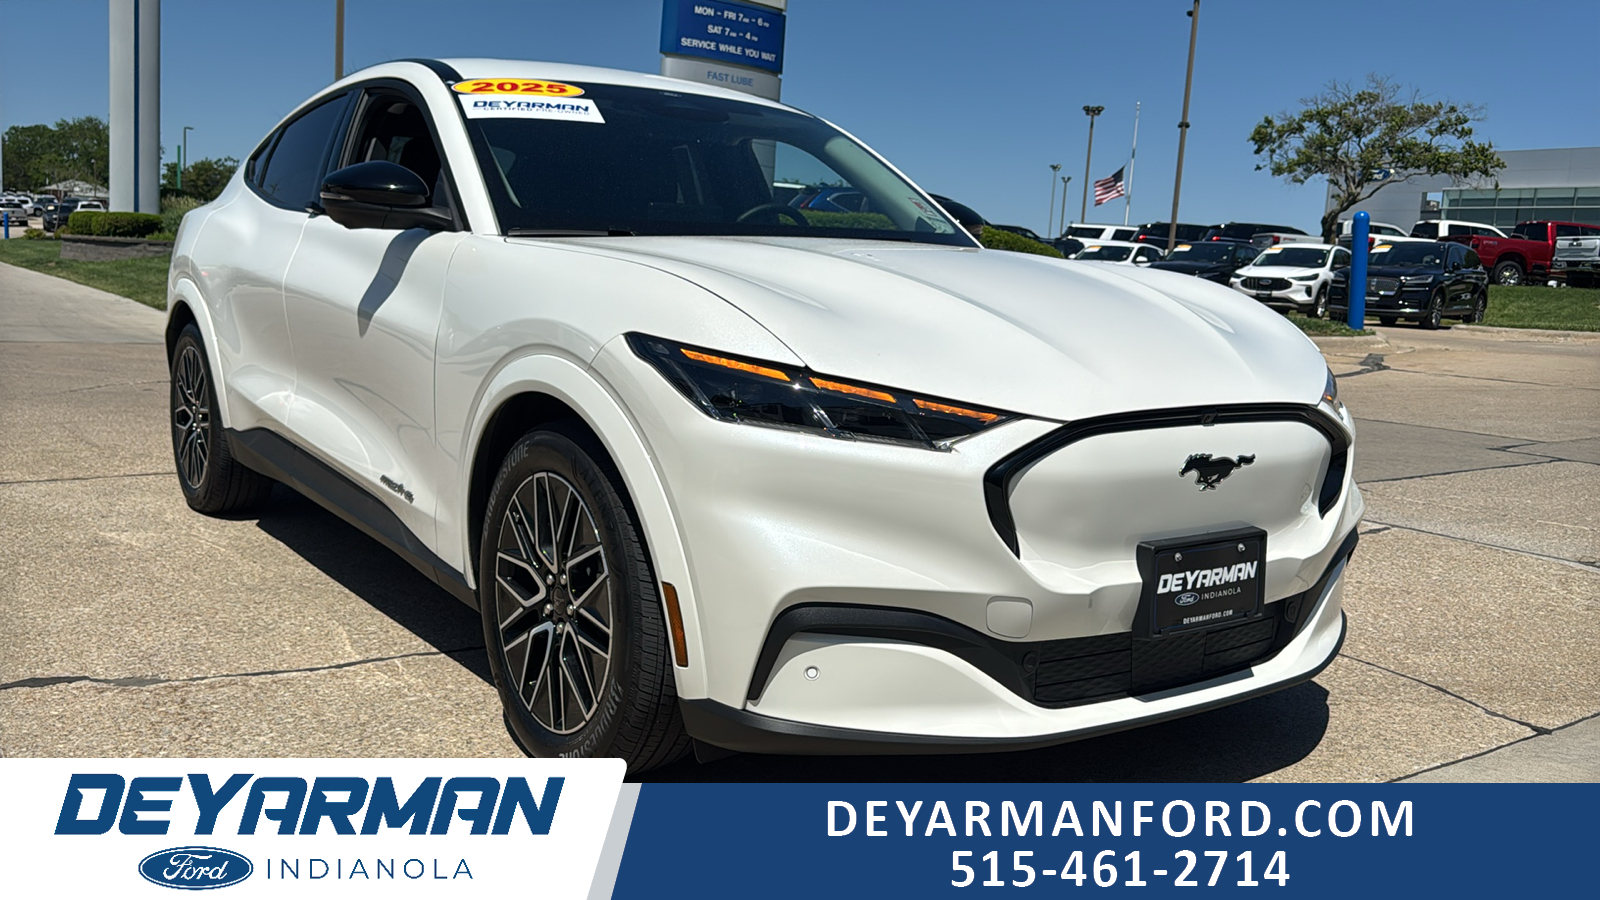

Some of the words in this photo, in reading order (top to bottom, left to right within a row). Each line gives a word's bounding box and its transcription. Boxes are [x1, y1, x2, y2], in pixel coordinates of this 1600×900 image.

[694, 5, 714, 17] MON
[723, 10, 737, 21] FRI
[707, 24, 723, 35] SAT
[680, 37, 717, 51] SERVICE
[718, 43, 743, 55] WHILE
[744, 48, 759, 59] YOU
[761, 52, 776, 62] WAIT
[707, 70, 729, 83] FAST
[731, 75, 754, 87] LUBE
[470, 82, 568, 94] 2025
[473, 101, 589, 112] DEYARMAN
[1157, 561, 1257, 594] DEYARMAN
[1201, 586, 1241, 600] INDIANOLA
